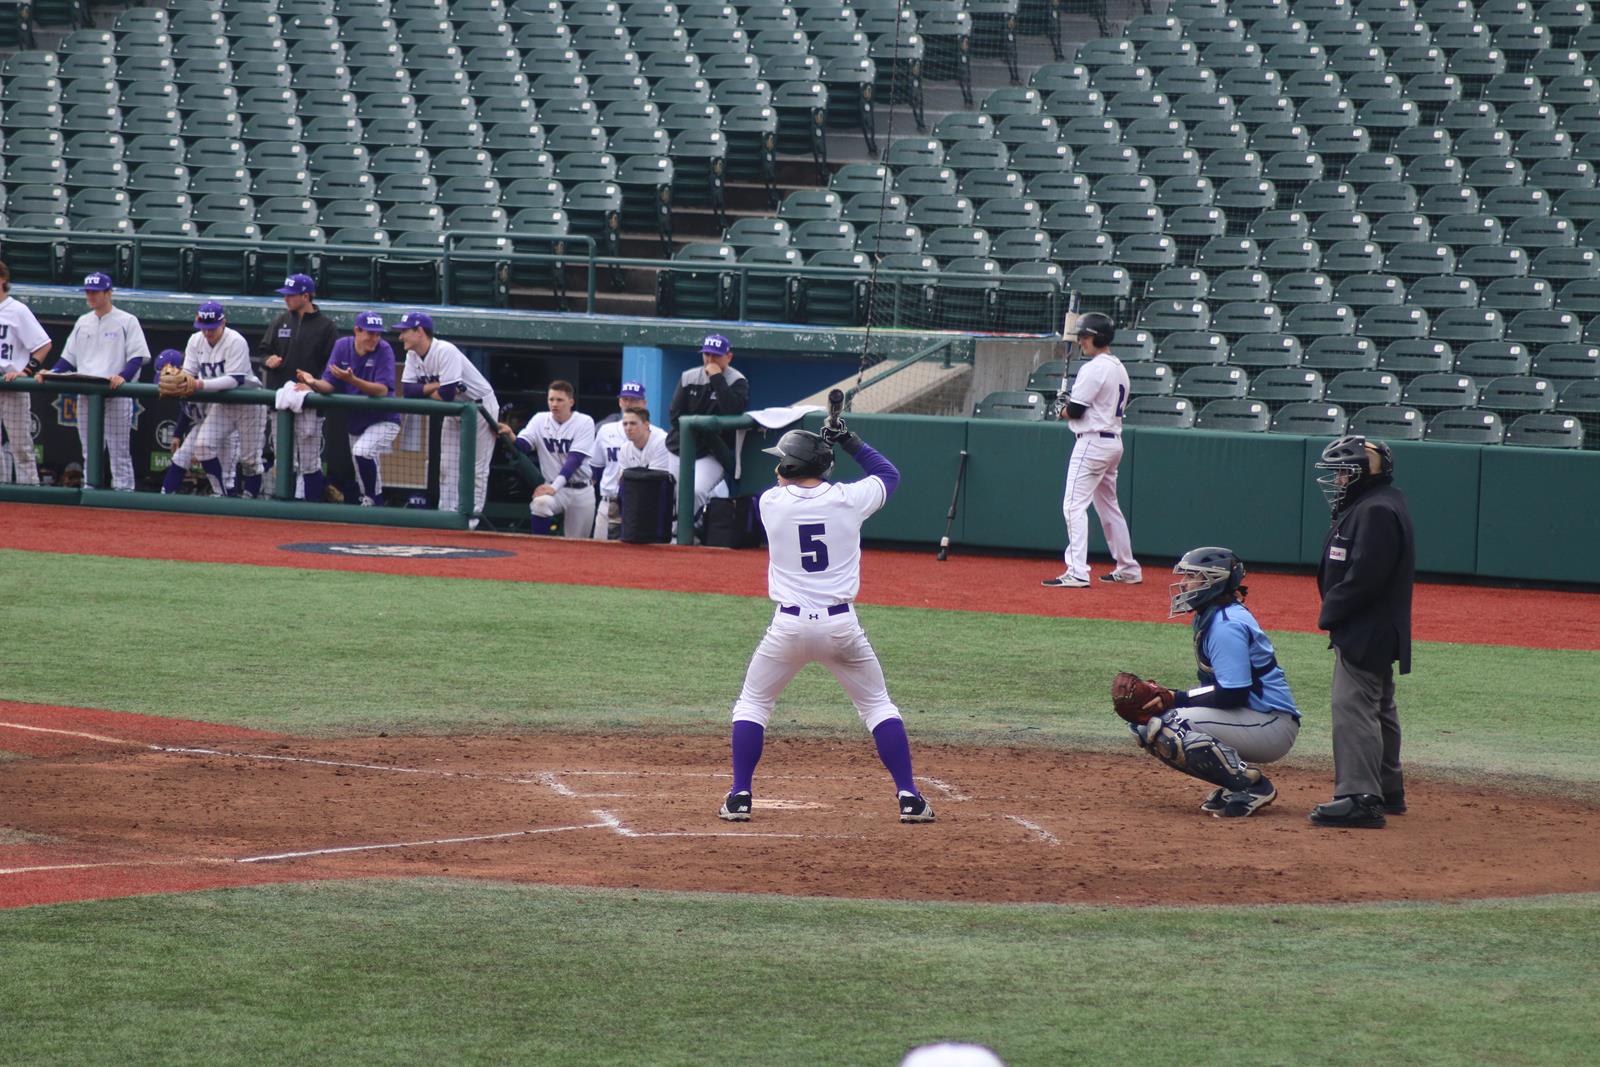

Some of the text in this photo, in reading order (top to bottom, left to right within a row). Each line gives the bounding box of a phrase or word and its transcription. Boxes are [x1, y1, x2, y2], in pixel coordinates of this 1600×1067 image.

[285, 278, 296, 287] YU
[198, 311, 215, 319] NYU
[704, 337, 722, 348] NYU
[1, 343, 13, 361] 21
[623, 383, 640, 392] NYU
[798, 523, 830, 573] 5
